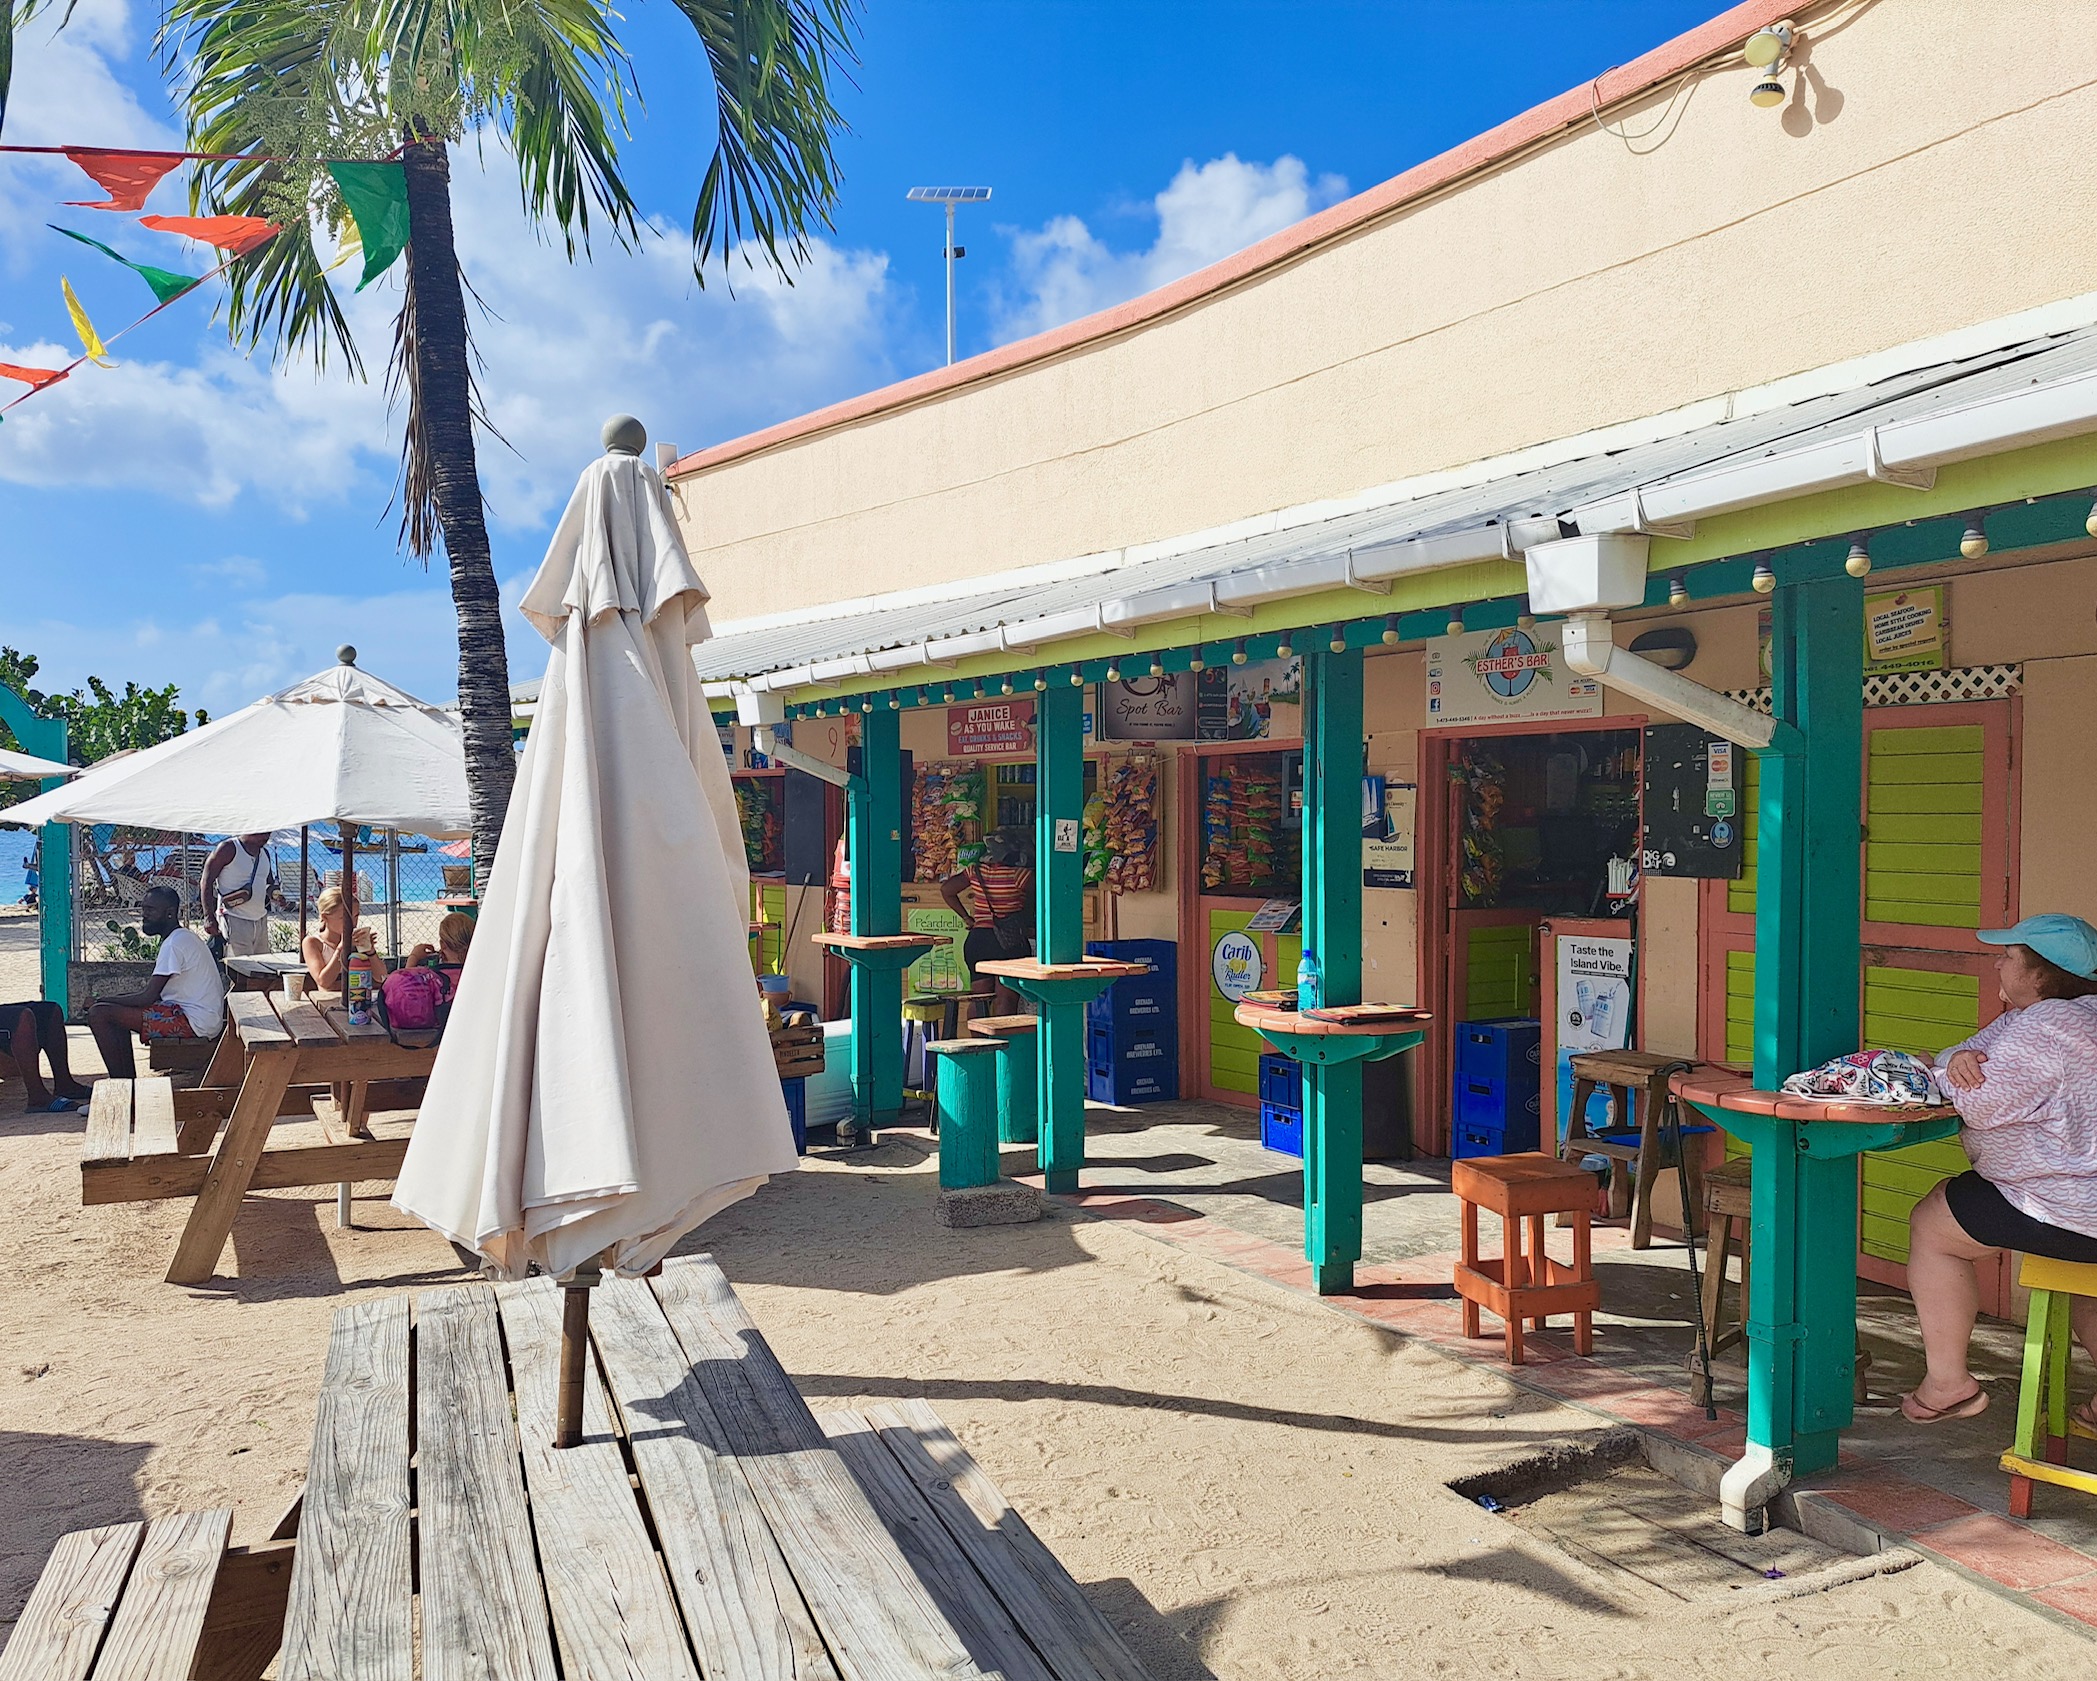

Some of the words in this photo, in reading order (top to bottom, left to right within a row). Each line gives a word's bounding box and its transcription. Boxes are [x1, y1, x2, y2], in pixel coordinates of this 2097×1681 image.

[1873, 614, 1890, 622] LOCAL
[1891, 606, 1915, 617] SEAFOOD
[1874, 622, 1890, 630] HOME
[1890, 617, 1906, 625] STYLE
[1906, 609, 1932, 620] COOKING
[1905, 619, 1924, 628] DISHES
[1875, 636, 1892, 644] LOCAL
[1893, 630, 1912, 640] JUICES
[1477, 657, 1524, 673] ESTHER'S
[1526, 654, 1548, 668] BAR
[1881, 660, 1935, 670] 449-4016
[970, 708, 1009, 721] JANICE
[1116, 698, 1148, 721] Spot
[1154, 699, 1184, 717] Bar
[964, 724, 974, 734] AS
[977, 722, 992, 732] YOU
[994, 720, 1016, 731] WAKE
[828, 727, 838, 759] 9
[970, 734, 991, 743] DRINKS
[998, 732, 1022, 741] SNACKS
[963, 743, 984, 753] QUALITY
[984, 743, 1005, 751] SERVICE
[1005, 742, 1017, 750] BAR
[1222, 943, 1252, 961] Carib
[1570, 944, 1597, 956] Taste
[1598, 946, 1614, 957] the
[1570, 958, 1597, 969] Island
[1600, 960, 1624, 972] Vibe.
[1225, 968, 1251, 982] Radler
[1134, 1043, 1155, 1051] GRENADA
[1127, 1050, 1153, 1058] BREWERIES
[1136, 1078, 1154, 1086] GRENADA
[1131, 1087, 1152, 1095] BREWERIES
